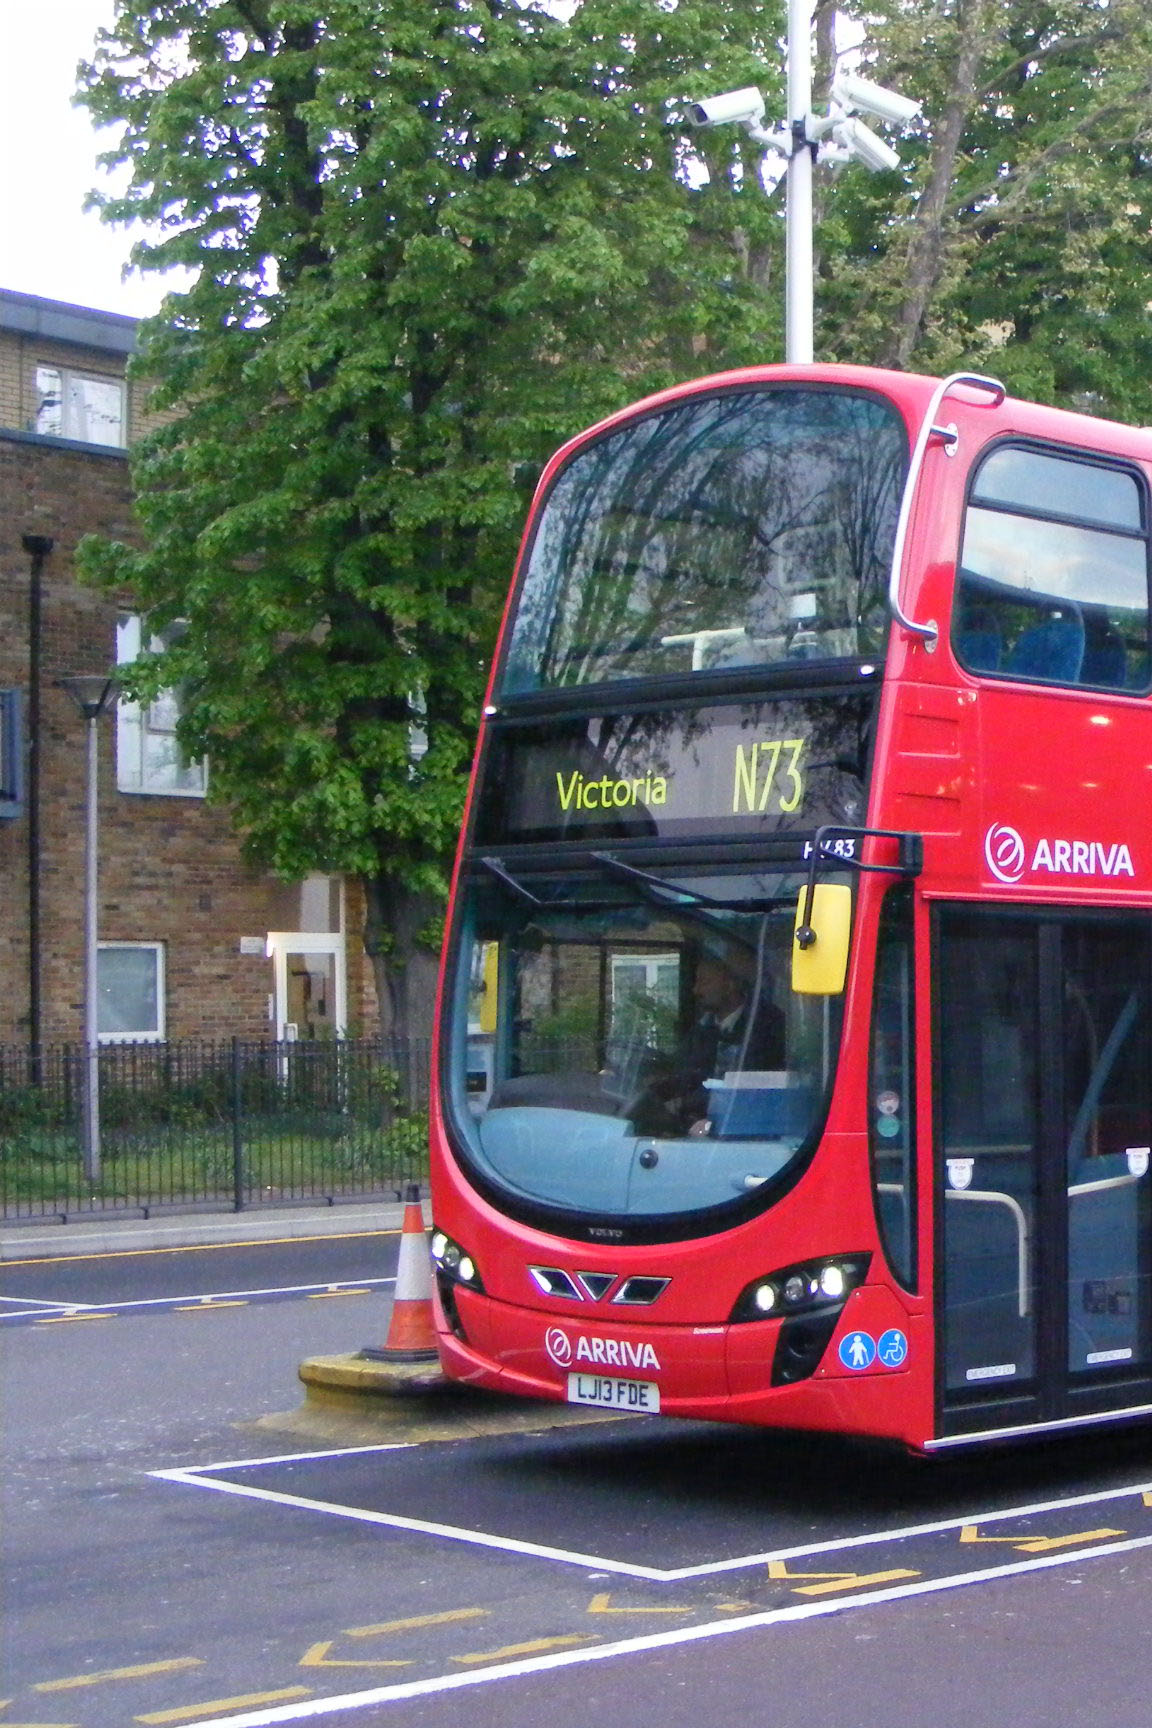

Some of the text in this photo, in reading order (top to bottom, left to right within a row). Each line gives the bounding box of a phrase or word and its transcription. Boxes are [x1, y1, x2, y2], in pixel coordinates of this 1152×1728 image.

[556, 769, 667, 810] Victoria
[732, 738, 805, 813] N73
[1031, 838, 1135, 876] ARRIVA
[576, 1336, 661, 1370] ARRIVA
[578, 1377, 649, 1406] LJ13 FDE
